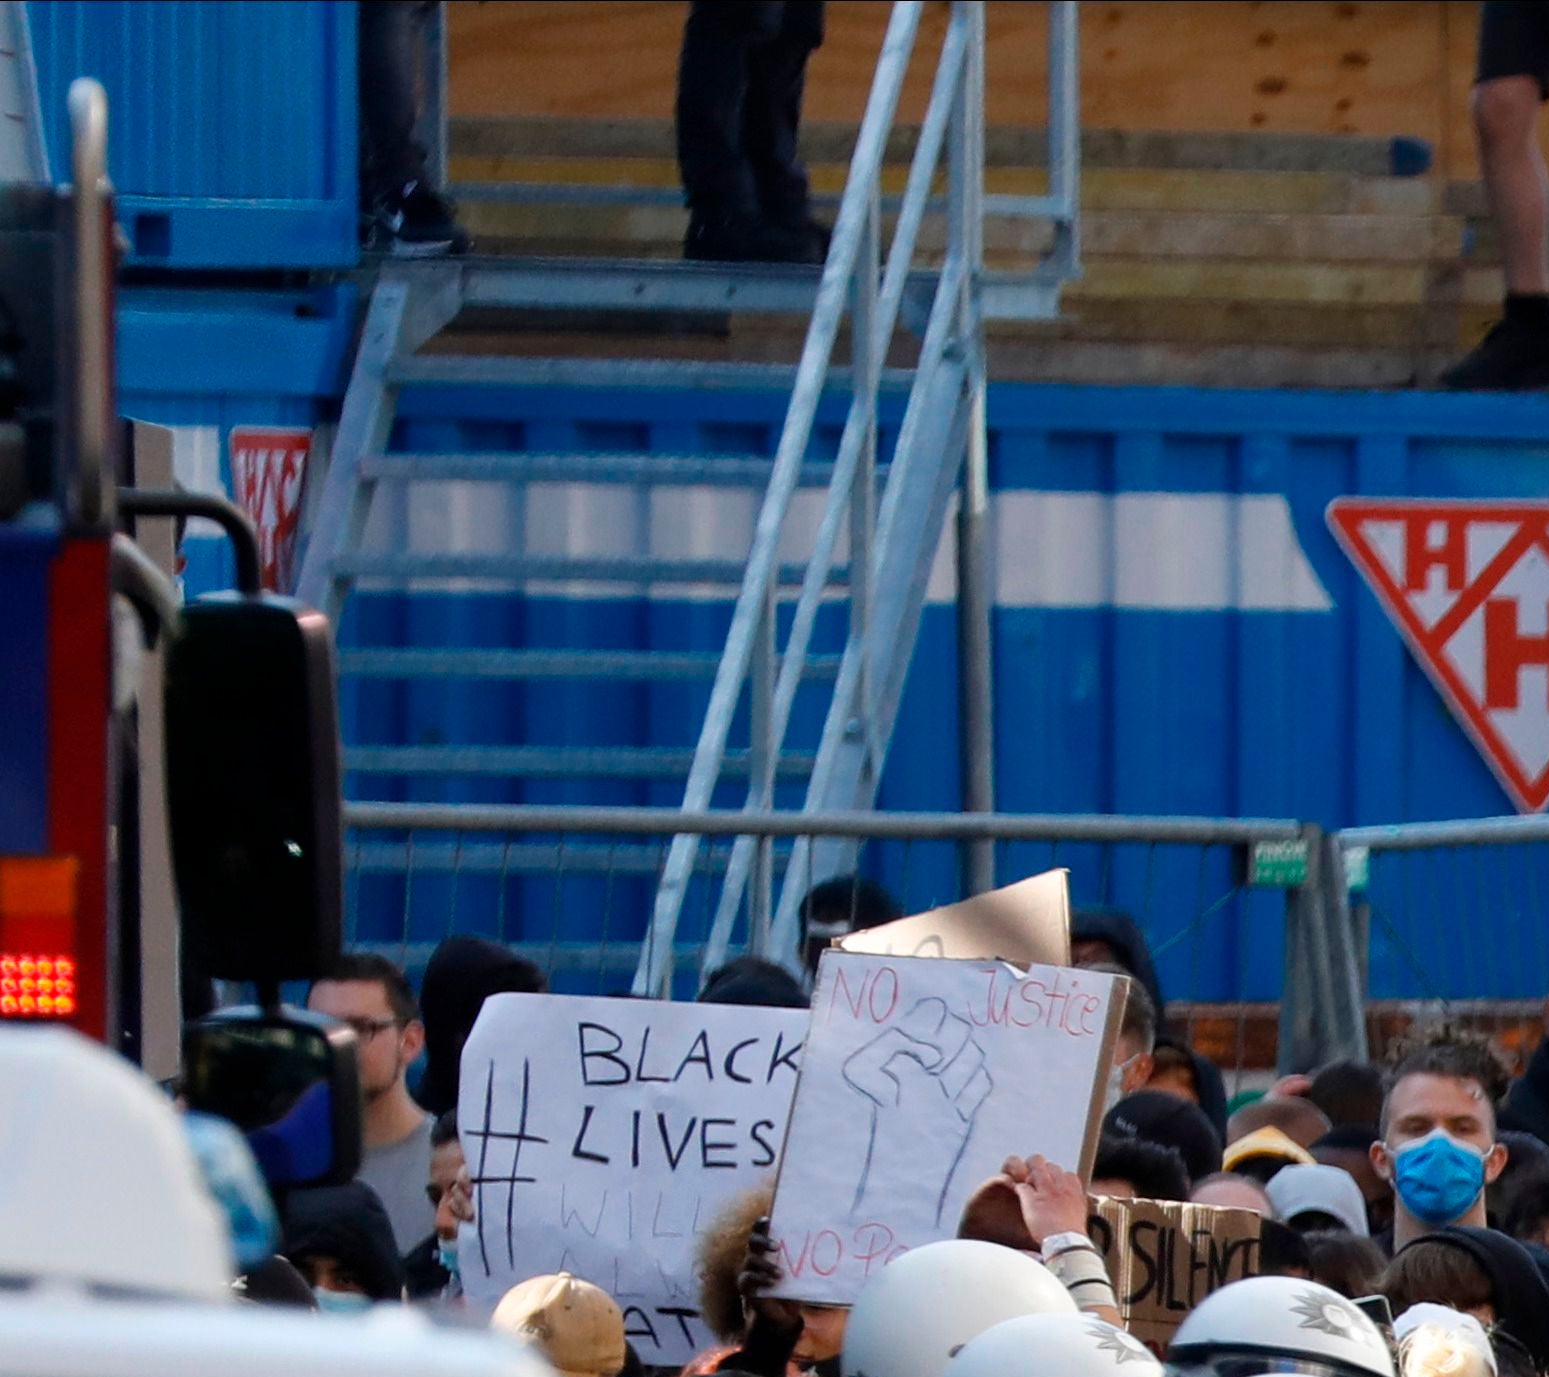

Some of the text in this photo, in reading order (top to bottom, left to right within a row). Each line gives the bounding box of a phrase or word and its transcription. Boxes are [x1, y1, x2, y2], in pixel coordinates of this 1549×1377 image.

[827, 966, 899, 1024] NO
[579, 1022, 804, 1086] BLACK
[572, 1105, 776, 1172] LIVES
[779, 1229, 843, 1278] NO
